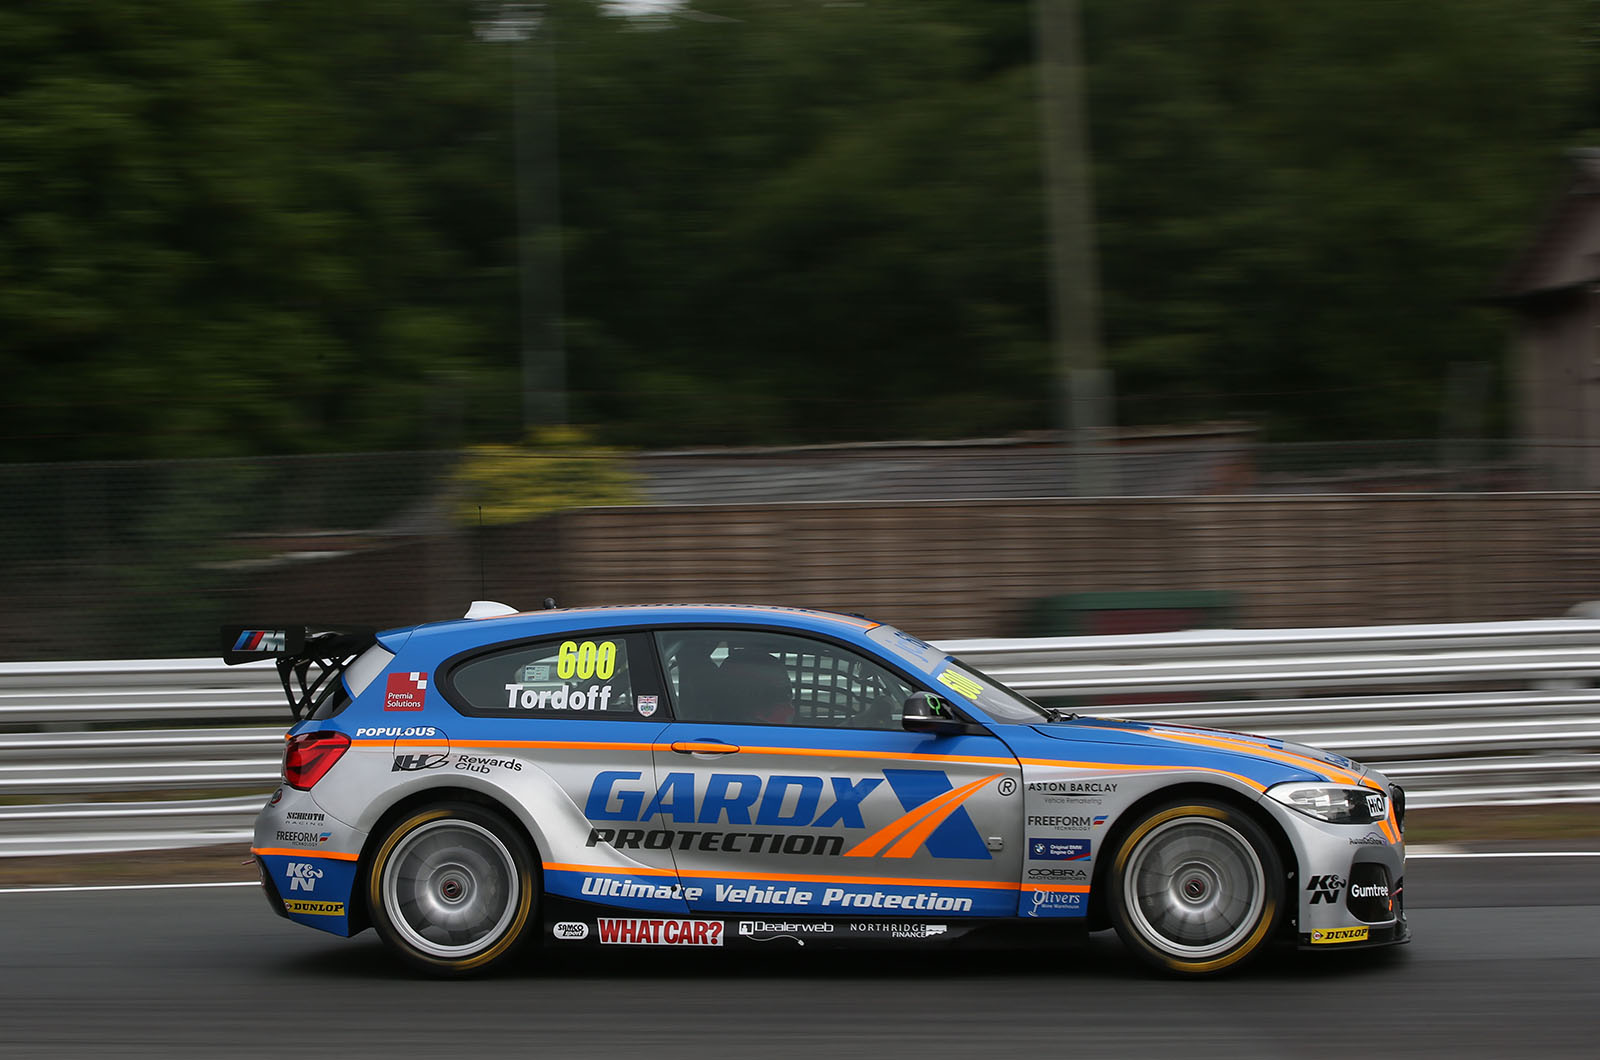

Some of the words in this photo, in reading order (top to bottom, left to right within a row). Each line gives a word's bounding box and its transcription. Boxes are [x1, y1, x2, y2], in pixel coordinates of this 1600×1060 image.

[557, 641, 616, 680] 600
[388, 692, 413, 700] Premia
[505, 684, 612, 711] Tordoff
[387, 700, 421, 708] Solutions
[356, 727, 436, 737] POPULOUS
[391, 754, 450, 772] IHG
[455, 763, 490, 775] Club
[458, 755, 523, 772] Rewards
[1028, 783, 1066, 792] ASTON
[1070, 783, 1118, 792] BARCLAY
[1367, 797, 1384, 813] HiQ
[286, 812, 325, 821] SCHROTH
[1027, 815, 1091, 826] FREEFORM
[276, 830, 318, 843] FREEFORM
[585, 829, 845, 857] PROTECTION
[1028, 868, 1087, 876] COBRA
[581, 877, 703, 901] Ultimate
[715, 884, 813, 906] Vehicle
[821, 888, 972, 912] Protection
[1351, 884, 1389, 898] Gumtree
[294, 903, 344, 912] DUNLOP
[755, 921, 834, 933] Dealerweb
[850, 923, 926, 932] NORTHRIDGE
[1325, 929, 1368, 940] DUNLOP
